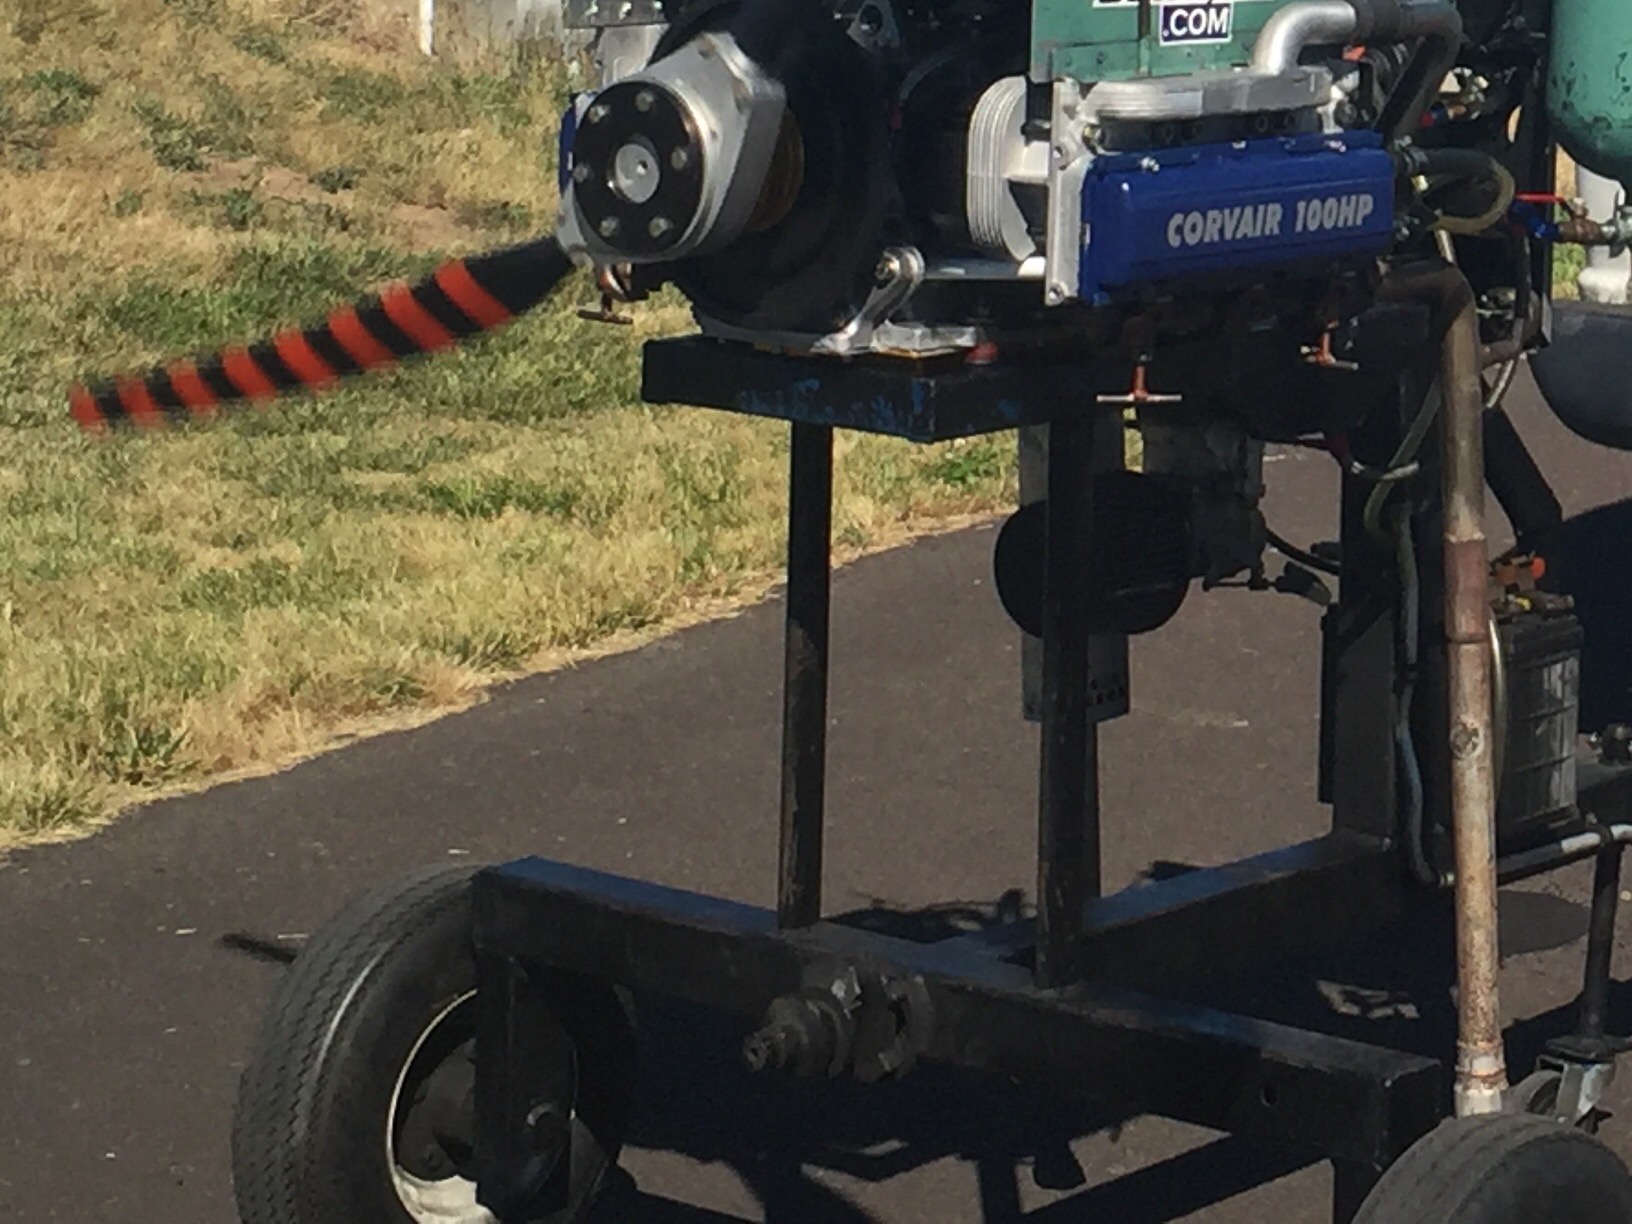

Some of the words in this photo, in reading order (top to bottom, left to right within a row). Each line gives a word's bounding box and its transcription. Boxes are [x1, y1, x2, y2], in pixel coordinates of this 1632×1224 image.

[1162, 6, 1229, 38] .COM
[1167, 203, 1283, 248] CORVAIR
[1295, 193, 1374, 233] 100HP
